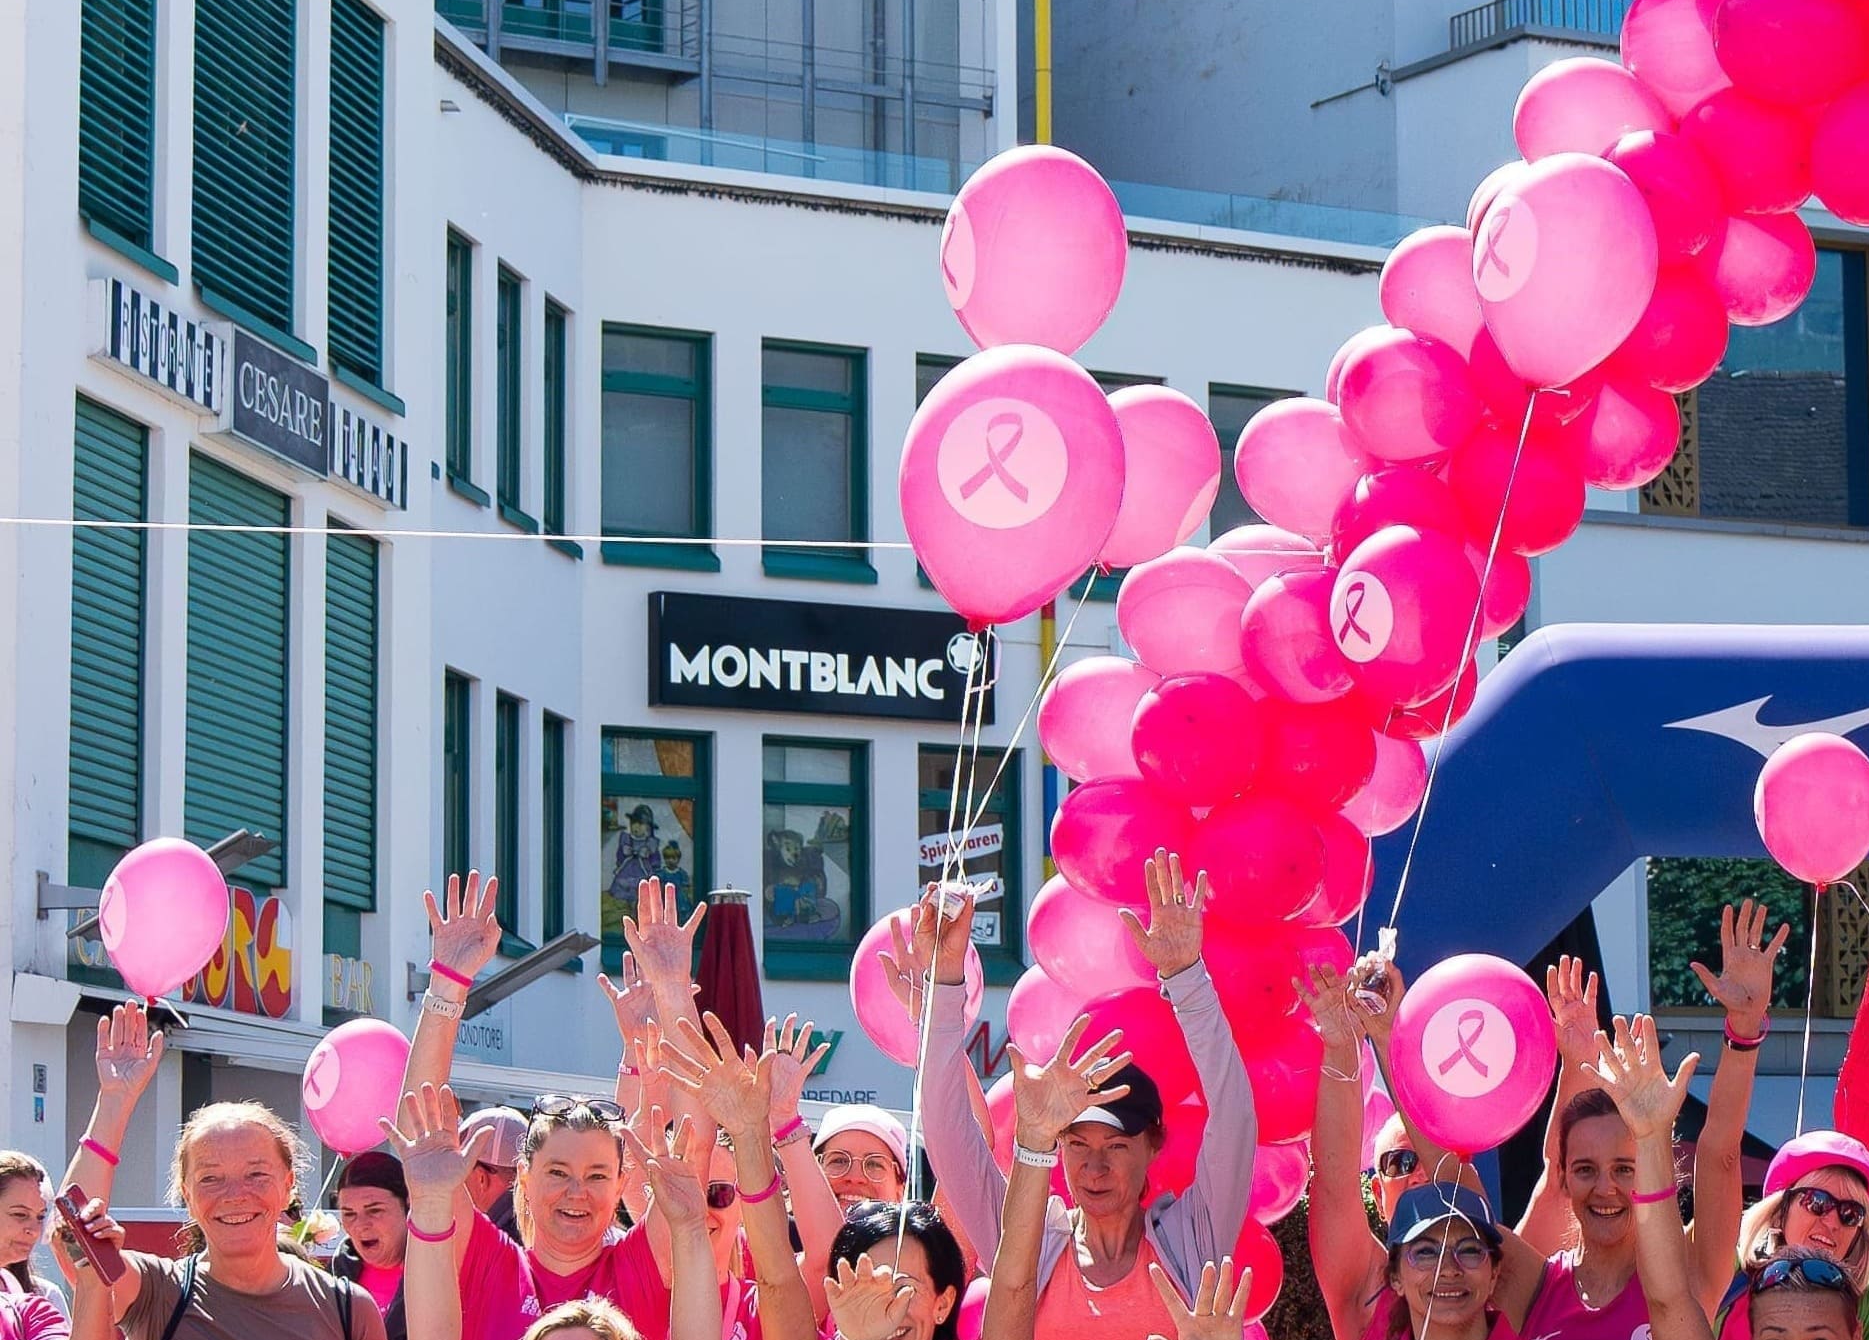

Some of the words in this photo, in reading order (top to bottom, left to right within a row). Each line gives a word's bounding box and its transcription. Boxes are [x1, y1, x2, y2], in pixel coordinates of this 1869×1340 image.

[122, 302, 212, 394] RISTORANTE
[238, 361, 323, 447] CESARE
[670, 643, 945, 700] MONTBLANC
[329, 954, 375, 1015] BAR
